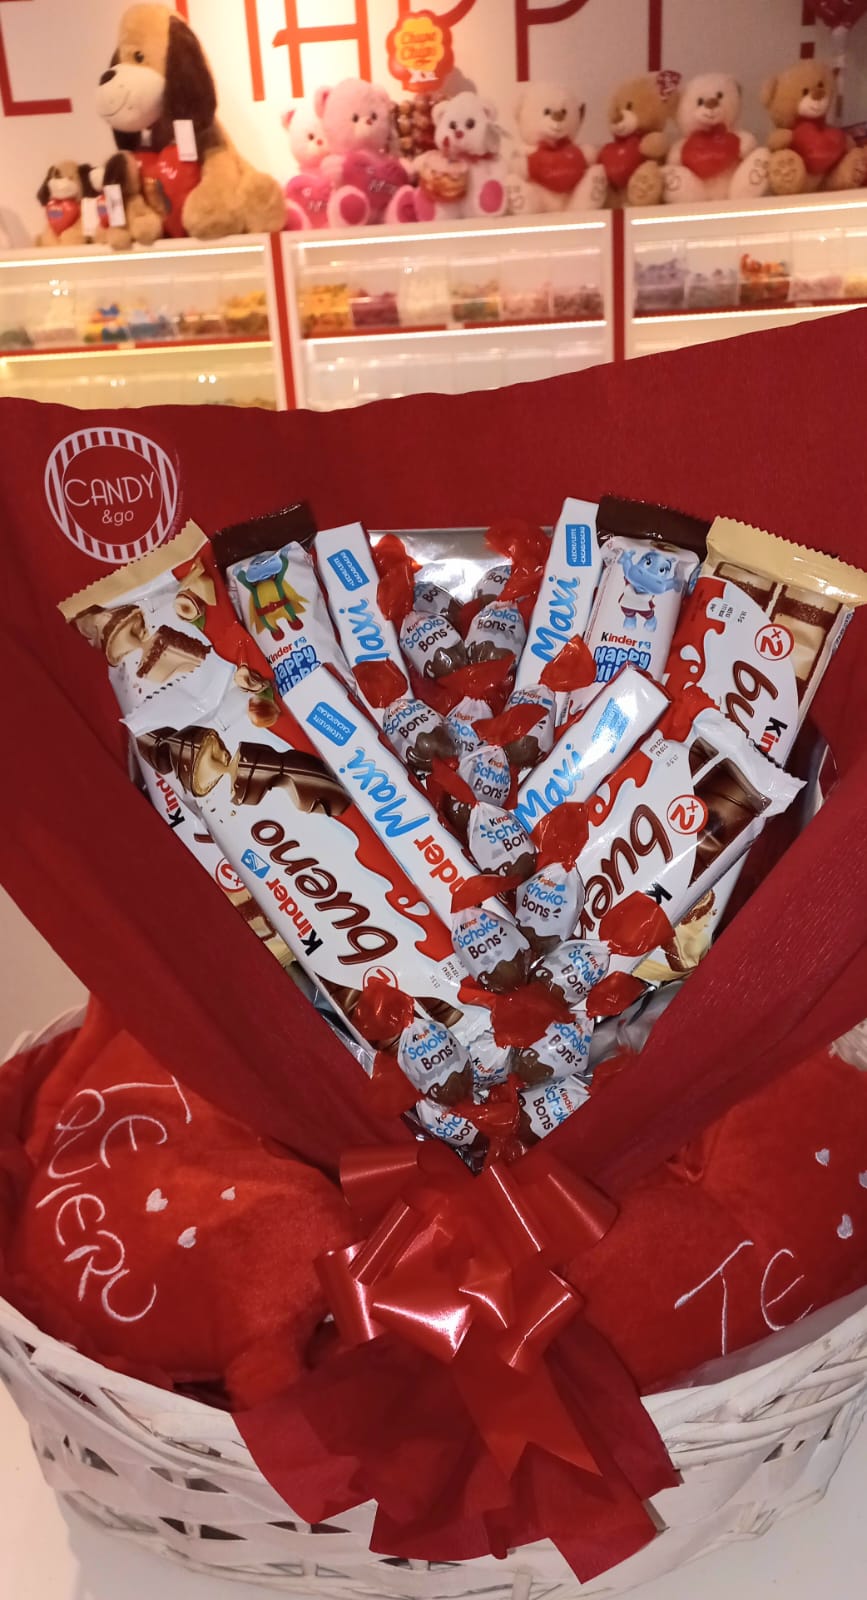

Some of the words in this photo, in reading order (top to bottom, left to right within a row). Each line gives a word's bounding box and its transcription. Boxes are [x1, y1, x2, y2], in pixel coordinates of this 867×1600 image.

[64, 471, 155, 507] CANDY
[101, 509, 134, 527] &go
[530, 575, 580, 662] Maxi
[266, 642, 293, 664] Kinder
[418, 629, 448, 652] Bons
[600, 631, 638, 646] Kinder
[399, 713, 430, 739] Bons
[338, 748, 431, 838] Maxi
[513, 743, 584, 833] Maxi
[670, 800, 699, 830] x2
[250, 819, 399, 966] bueno
[521, 894, 551, 919] Bons
[265, 877, 324, 957] Kinder
[468, 934, 502, 960] Bons
[420, 1046, 453, 1071] Bons
[532, 1097, 554, 1131] Bons
[674, 1240, 814, 1356] TE
